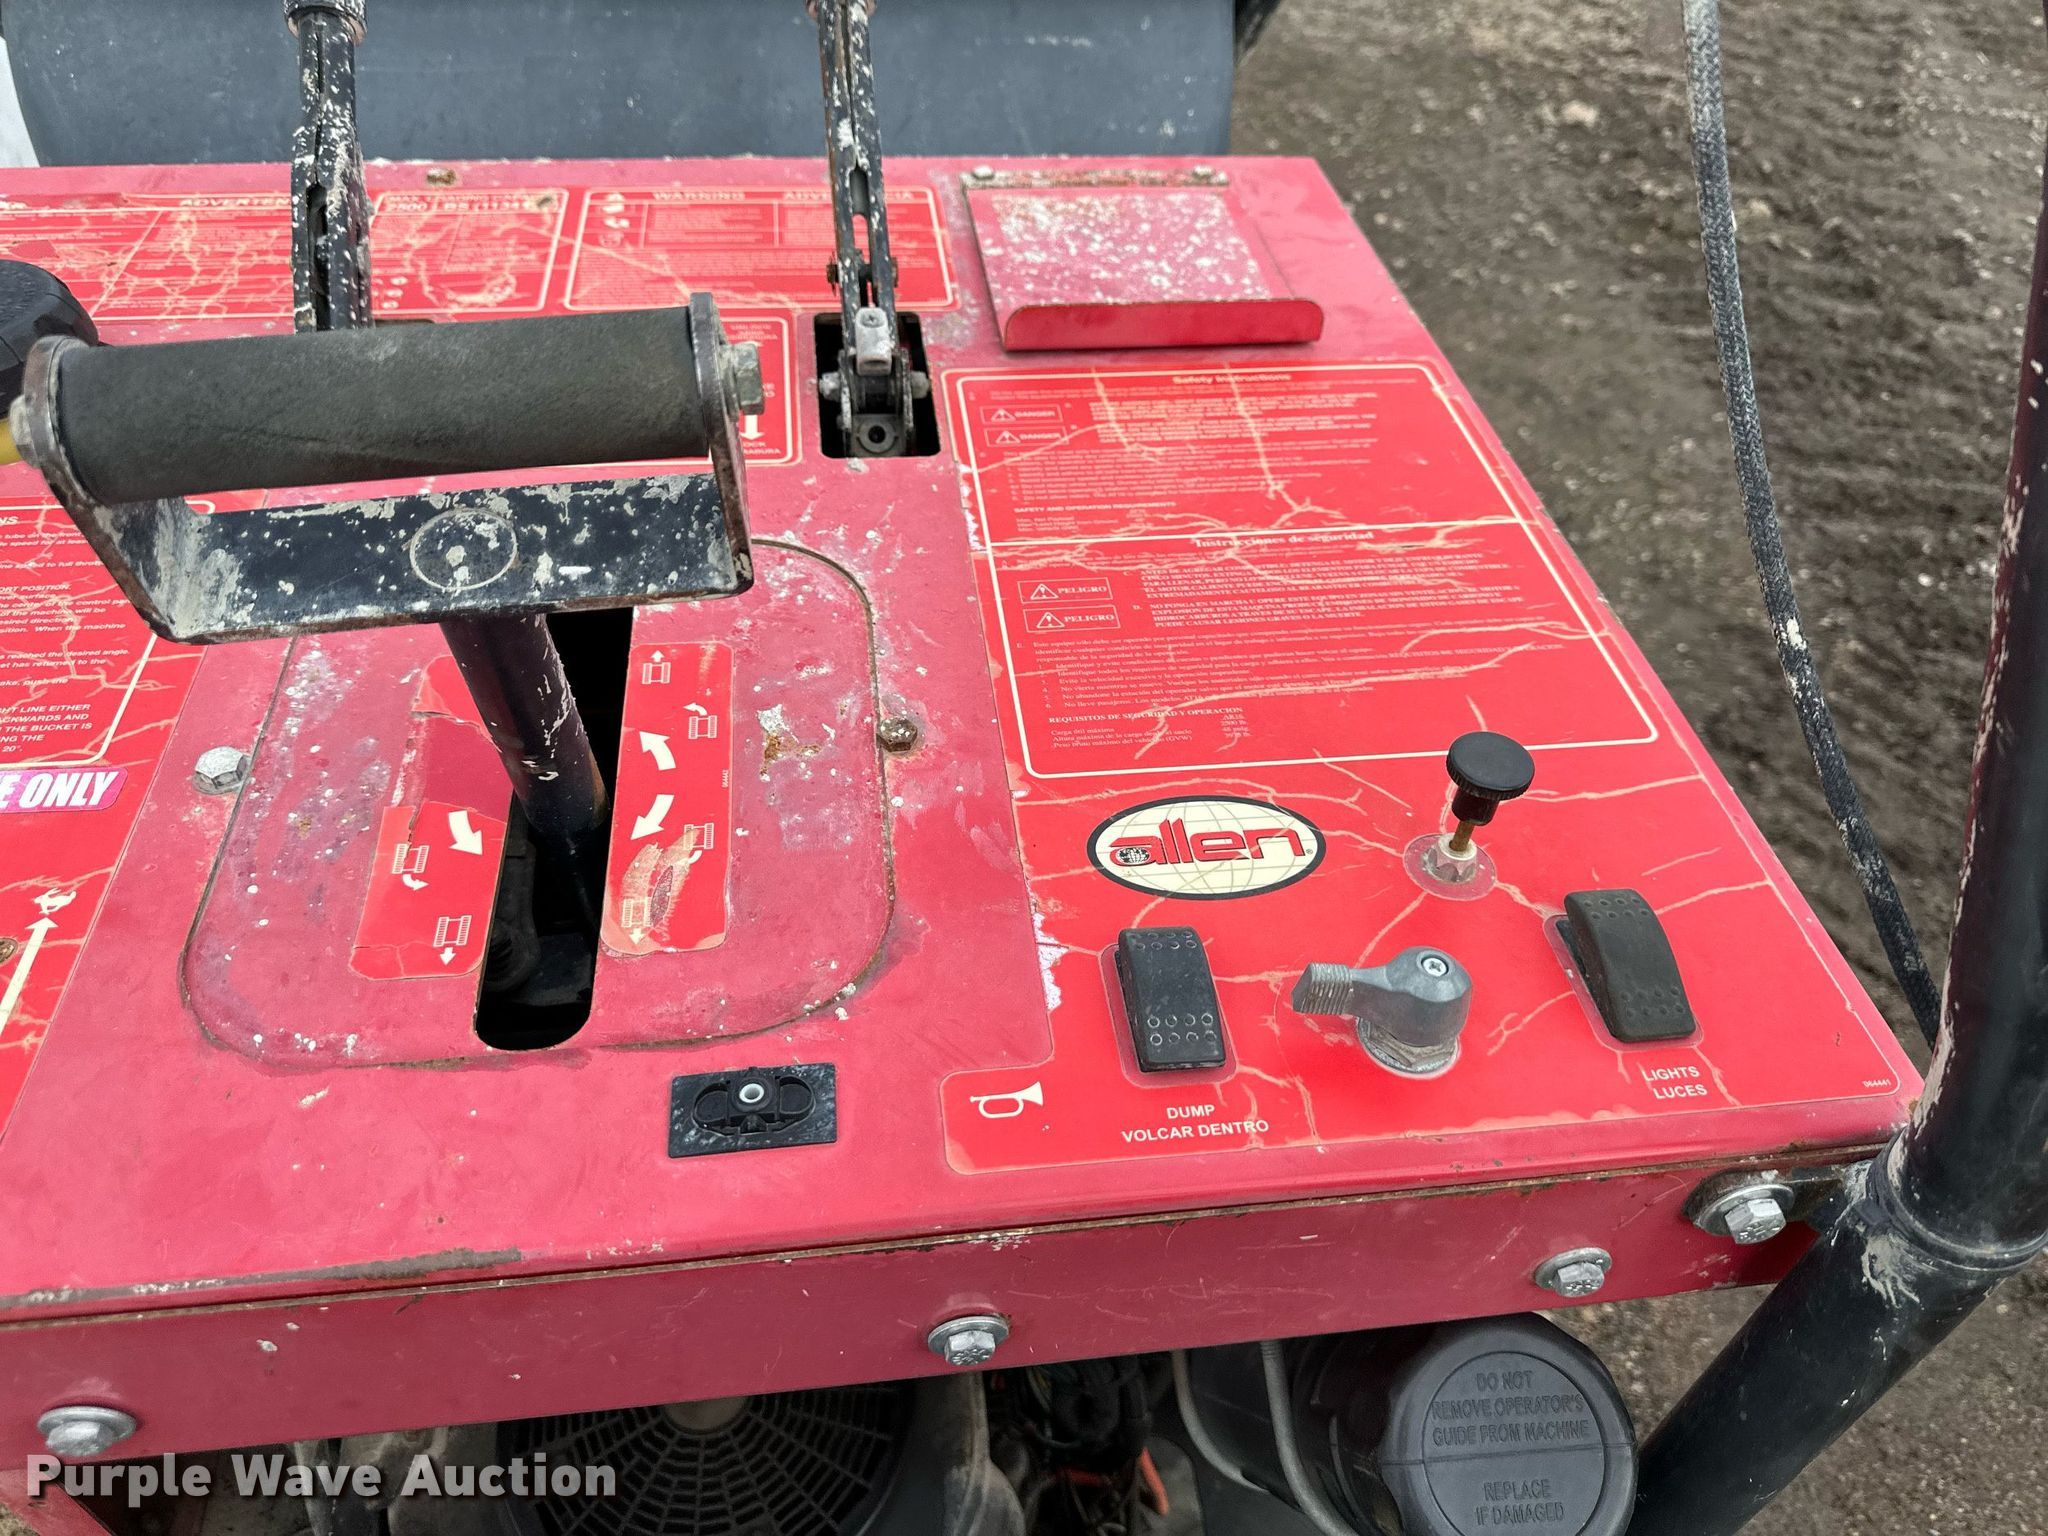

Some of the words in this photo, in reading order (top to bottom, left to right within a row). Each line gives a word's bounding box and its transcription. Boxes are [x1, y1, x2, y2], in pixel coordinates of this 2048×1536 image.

[1015, 410, 1055, 418] DANGER
[1019, 432, 1061, 440] DANGER
[1289, 535, 1304, 543] de
[1307, 531, 1373, 543] seguridad
[1058, 585, 1107, 594] PELIGRO
[1064, 614, 1114, 622] PELIGRO
[20, 705, 46, 713] LINE
[48, 704, 91, 712] EITHER
[1049, 715, 1106, 723] REQUISITOS
[1188, 708, 1243, 716] OPERACION
[63, 713, 89, 721] AND
[5, 725, 28, 733] THE
[31, 723, 78, 732] BUCKET
[81, 722, 93, 730] IS
[21, 734, 45, 742] THE
[18, 770, 119, 808] ONLY
[1109, 818, 1306, 867] allen
[1641, 1065, 1700, 1082] LIGHTS
[1653, 1084, 1708, 1100] LUCES
[1166, 1104, 1215, 1119] DUMP
[1122, 1125, 1194, 1143] VOLCAR
[1198, 1120, 1269, 1137] DENTRO
[1476, 1371, 1498, 1392] DO
[1501, 1369, 1535, 1390] NOT
[1431, 1398, 1492, 1421] REMOVE
[1494, 1393, 1585, 1418] OPERATOR'S
[1432, 1425, 1476, 1447] GUIDE
[1480, 1422, 1521, 1444] FROM
[1524, 1419, 1590, 1443] MACHINE
[1483, 1479, 1551, 1501] REPLACE
[1476, 1506, 1490, 1526] IF
[1493, 1501, 1564, 1525] DAMAGED
